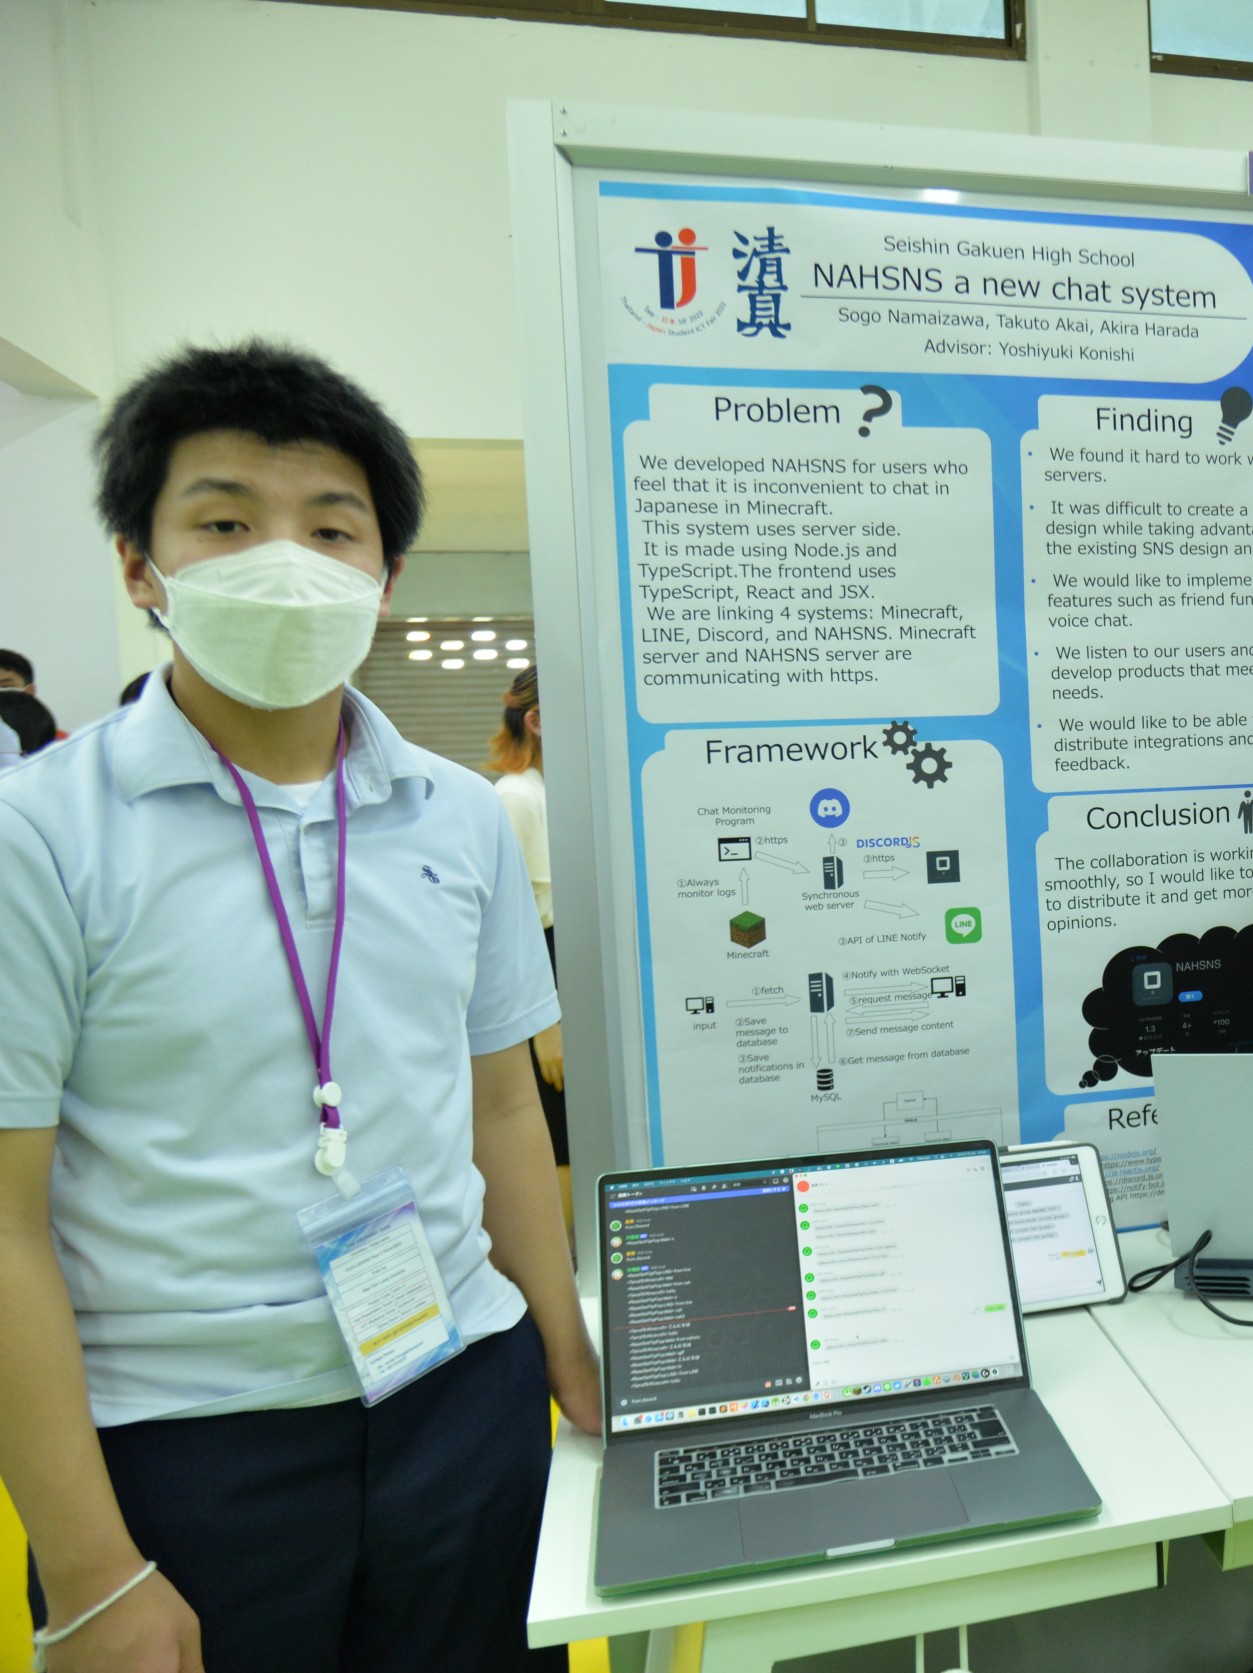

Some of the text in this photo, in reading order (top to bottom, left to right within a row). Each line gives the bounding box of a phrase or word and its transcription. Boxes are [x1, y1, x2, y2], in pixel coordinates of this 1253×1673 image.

[884, 236, 1134, 267] Seishin Gakuen High School
[814, 263, 1216, 311] NAHSNS a new chat system
[838, 307, 1199, 338] Sogo Namaizawa, Takuto Akai, Akira Harada
[924, 339, 1134, 362] Advisor: Yoshiyuki Konishi
[715, 397, 840, 424] Problem
[1096, 407, 1192, 439] Finding
[639, 455, 968, 475] We developed NAHSNS for users who
[1049, 447, 1074, 462] We
[1080, 447, 1124, 463] found
[1130, 449, 1140, 463] it
[1145, 449, 1179, 464] hard
[1185, 451, 1200, 464] to
[1205, 452, 1242, 465] work
[1044, 470, 1106, 482] servers.
[635, 498, 833, 516] Japanese in Minecraft.
[642, 519, 900, 539] This system uses server side.
[1046, 520, 1097, 538] design
[1103, 521, 1143, 535] while
[1148, 522, 1194, 539] taking
[644, 541, 897, 561] It is made using Node.js and
[778, 563, 851, 578] frontend
[858, 567, 896, 578] uses
[638, 584, 875, 603] TypeScript, React and JSX.
[1047, 593, 1112, 608] features
[1117, 593, 1153, 607] such
[1159, 596, 1176, 607] as
[1181, 592, 1225, 606] friend
[1048, 613, 1132, 628] voice chat.
[642, 624, 976, 645] LINE, Discord, and NAHSNS. Minecraft
[644, 668, 878, 687] communicating with https.
[706, 735, 879, 764] Framework
[1054, 737, 1128, 752] distribute
[1134, 733, 1224, 751] integrations
[1055, 756, 1130, 772] feedback.
[697, 806, 771, 816] Chat Monitoring
[1087, 802, 1230, 830] Conclusion
[715, 817, 755, 827] Program
[1054, 857, 1085, 871] The
[1090, 851, 1188, 869] collaboration
[1194, 850, 1205, 863] is
[677, 888, 736, 898] monitor logs
[801, 891, 860, 902] Synchronous
[1046, 898, 1062, 911] to
[1067, 893, 1140, 910] distribute
[1146, 891, 1156, 904] it
[1161, 888, 1188, 904] and
[1194, 888, 1218, 904] get
[804, 901, 855, 911] web server
[954, 920, 973, 928] LINE
[1047, 915, 1116, 934] opinions.
[865, 935, 875, 944] of
[877, 933, 898, 943] LINE
[900, 932, 927, 942] Notify
[727, 949, 769, 959] Minecraft
[880, 968, 899, 977] with
[902, 965, 950, 975] WebSocket
[1176, 959, 1222, 972] NAHSNS
[693, 1022, 717, 1032] input
[879, 1024, 919, 1034] message
[921, 1020, 954, 1031] content
[866, 1054, 905, 1063] message
[907, 1051, 928, 1060] from
[930, 1048, 970, 1058] database
[811, 1092, 842, 1103] MySQL
